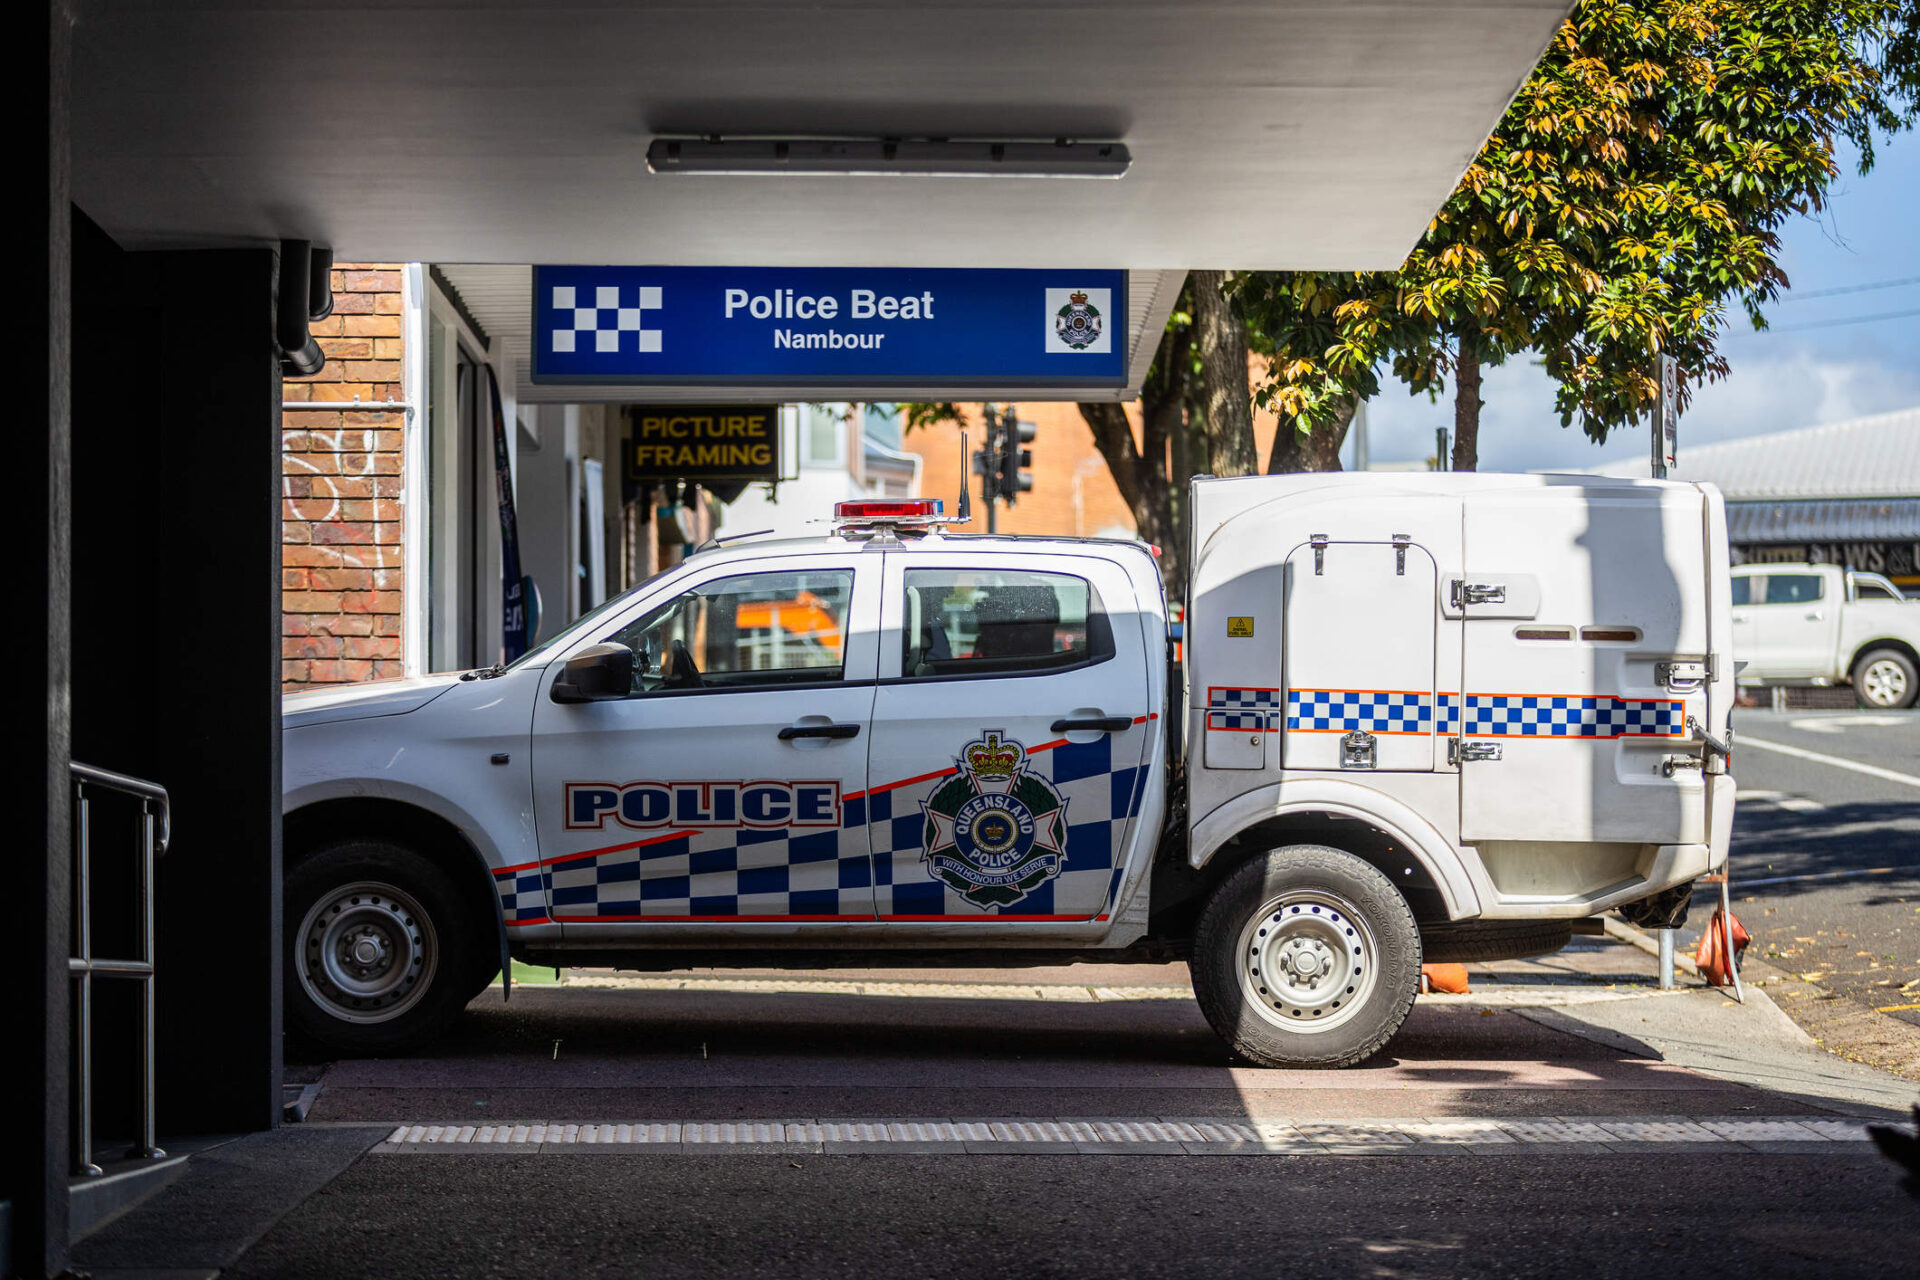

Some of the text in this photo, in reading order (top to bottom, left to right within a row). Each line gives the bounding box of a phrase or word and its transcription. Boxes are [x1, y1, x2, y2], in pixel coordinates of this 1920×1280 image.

[725, 288, 935, 320] Police Beat
[774, 328, 885, 350] Nambour
[641, 415, 767, 438] PICTURE
[636, 443, 772, 466] FRAMING
[568, 784, 838, 826] POLICE
[956, 795, 1033, 835] QUEENSLAND
[968, 847, 1022, 867] POLICE
[942, 857, 1048, 886] WITH HONOUR WE SERVE
